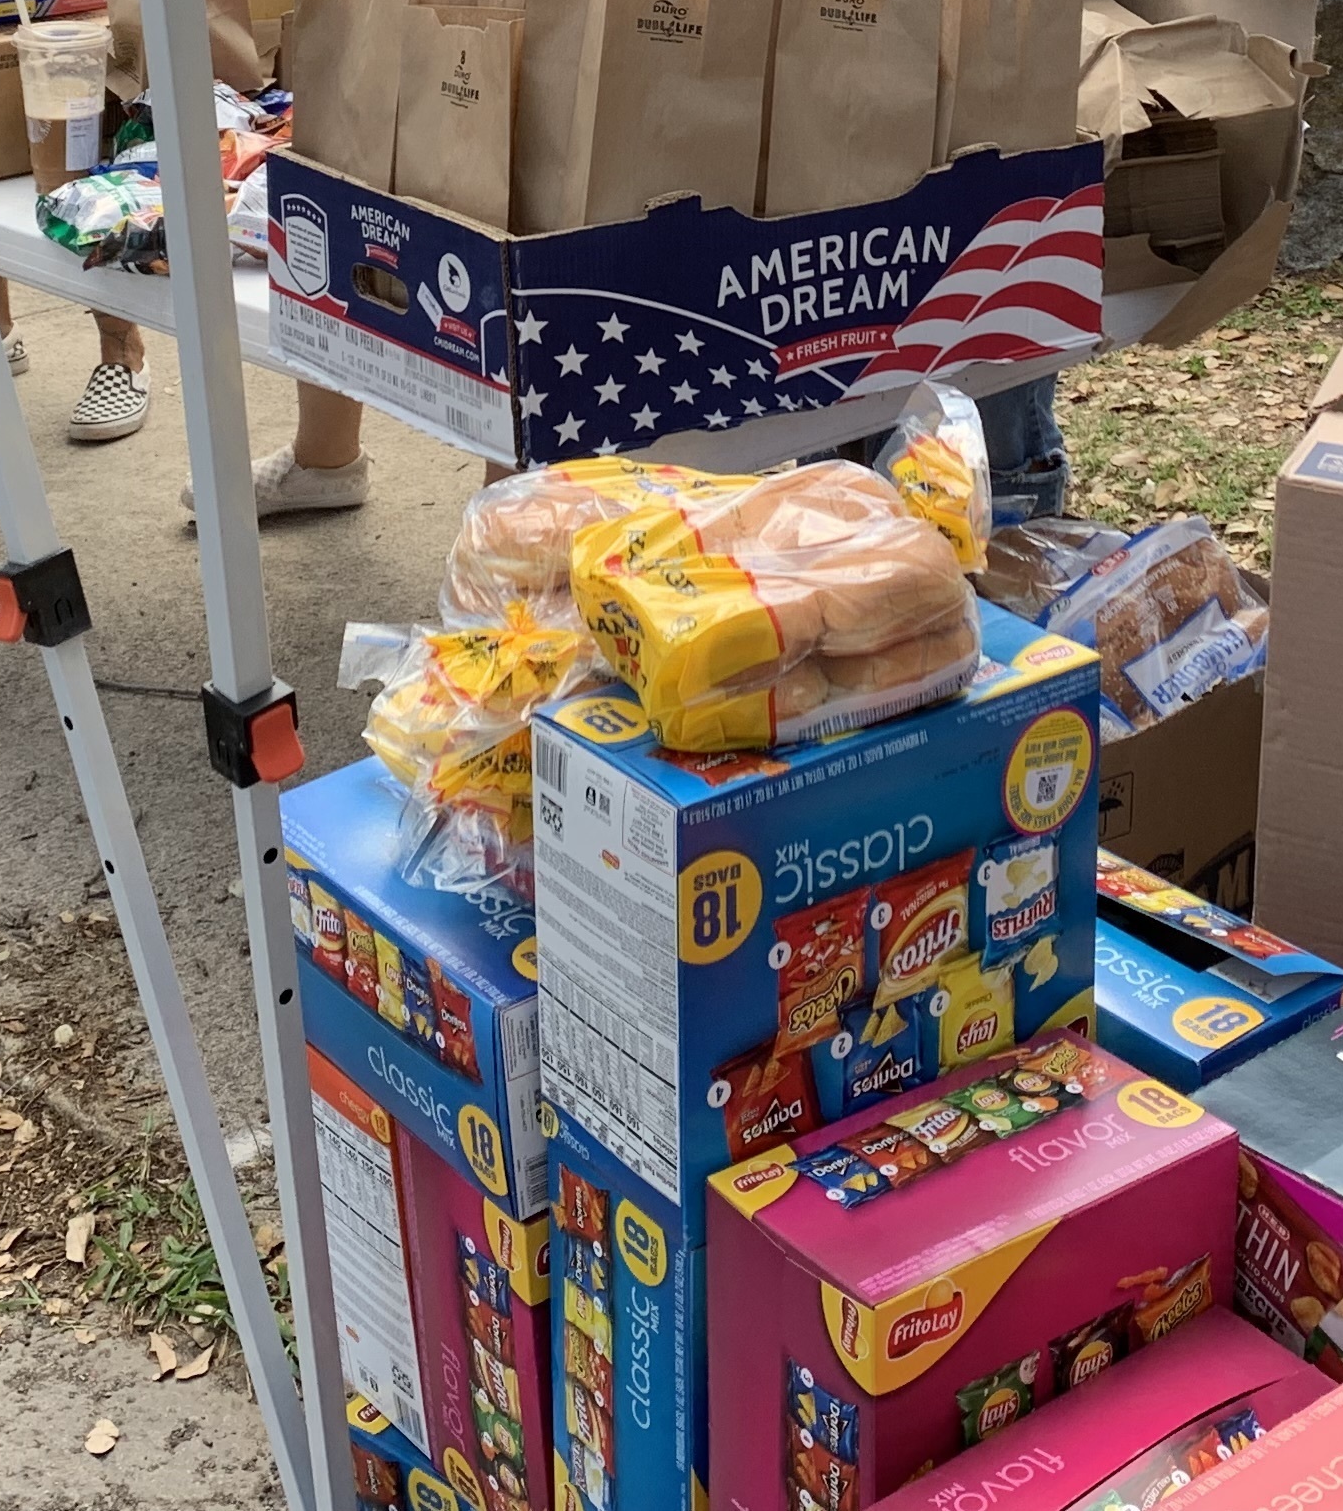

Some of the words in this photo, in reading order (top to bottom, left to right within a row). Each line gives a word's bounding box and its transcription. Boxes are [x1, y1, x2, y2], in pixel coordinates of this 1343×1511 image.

[653, 1, 689, 17] DURO
[855, 12, 878, 24] LIFE
[675, 23, 703, 36] LIFE
[351, 204, 410, 242] AMERICAN
[361, 222, 401, 252] DREAM
[716, 225, 951, 309] AMERICAN
[760, 268, 908, 336] DREAM
[795, 336, 839, 361] FRESH
[840, 330, 877, 347] FRUIT
[583, 709, 639, 734] 18
[774, 814, 933, 905] classic
[775, 838, 810, 862] MIX
[694, 862, 742, 891] BAGS
[982, 865, 991, 880] 3
[478, 919, 511, 941] MIX
[693, 884, 742, 948] 18
[877, 907, 886, 923] 3
[991, 890, 1056, 940] RUFFLES
[775, 947, 784, 964] 4
[892, 907, 963, 979] Fritos
[788, 966, 857, 1036] Cheetos
[936, 996, 944, 1011] 2
[1132, 989, 1164, 1010] MIX
[1194, 1003, 1249, 1034] 18
[837, 1038, 846, 1053] 2
[368, 1046, 453, 1134] classic
[852, 1058, 913, 1098] Doritos
[715, 1086, 724, 1102] 4
[1127, 1087, 1179, 1115] 18
[743, 1099, 803, 1144] Doritos
[911, 1106, 962, 1141] Fritos
[1156, 1105, 1192, 1125] BAGS
[437, 1129, 457, 1151] MIX
[466, 1117, 495, 1167] 18
[862, 1130, 909, 1156] Doritos
[1008, 1113, 1125, 1173] flavor
[1105, 1131, 1136, 1150] MIX
[813, 1153, 860, 1178] Doritos
[623, 1216, 649, 1266] 18
[1236, 1200, 1301, 1292] THIN
[650, 1300, 660, 1334] MIX
[893, 1307, 958, 1346] FritoLay
[626, 1286, 651, 1429] classic
[1073, 1348, 1110, 1386] Lay's
[441, 1341, 466, 1452] flavor
[829, 1401, 842, 1454] Doritos
[981, 1395, 1017, 1430] Lay's
[928, 1482, 966, 1507] MIX
